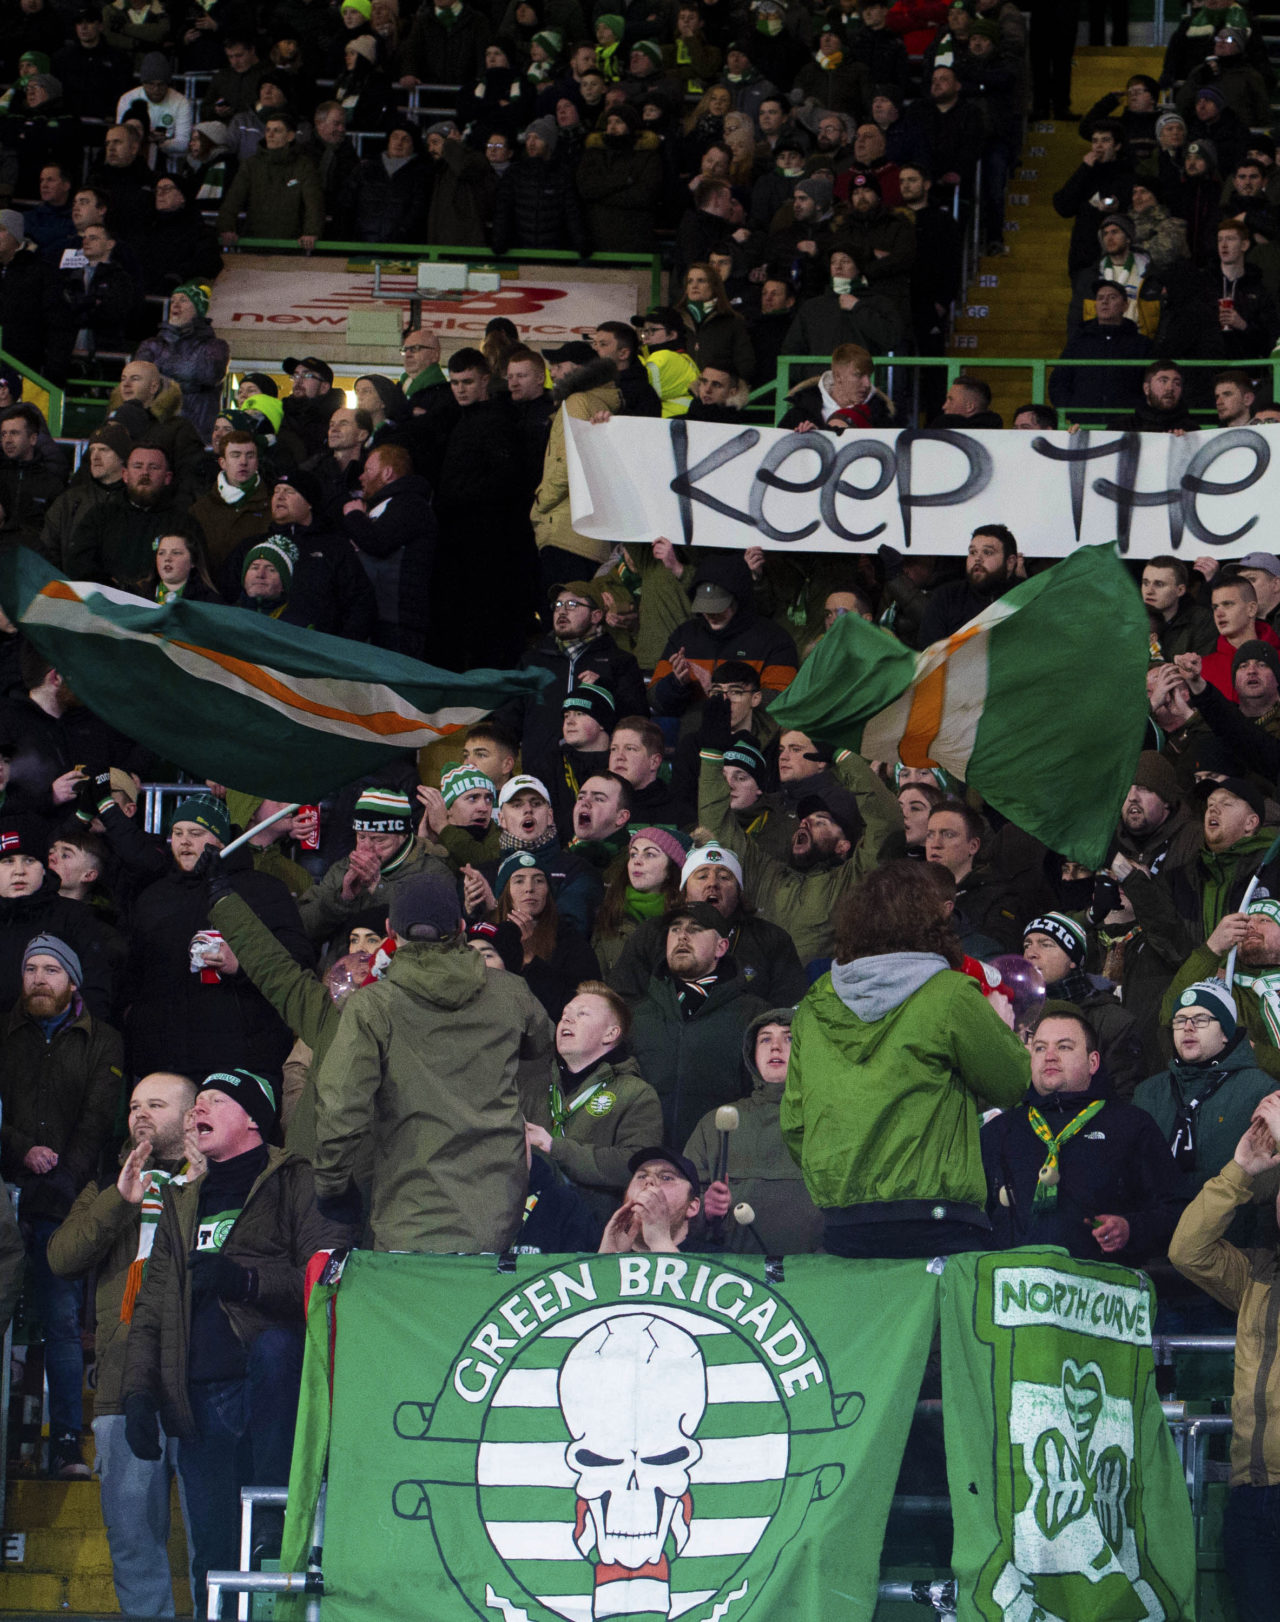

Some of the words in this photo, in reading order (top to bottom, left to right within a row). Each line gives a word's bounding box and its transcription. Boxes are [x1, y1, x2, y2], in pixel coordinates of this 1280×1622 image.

[232, 312, 347, 326] new
[403, 318, 597, 336] alance
[967, 306, 988, 318] GG
[1001, 1280, 1090, 1321] NORTH
[1090, 1293, 1147, 1338] CURVE
[454, 1263, 598, 1403] GREEN
[619, 1257, 824, 1398] BRIGADE
